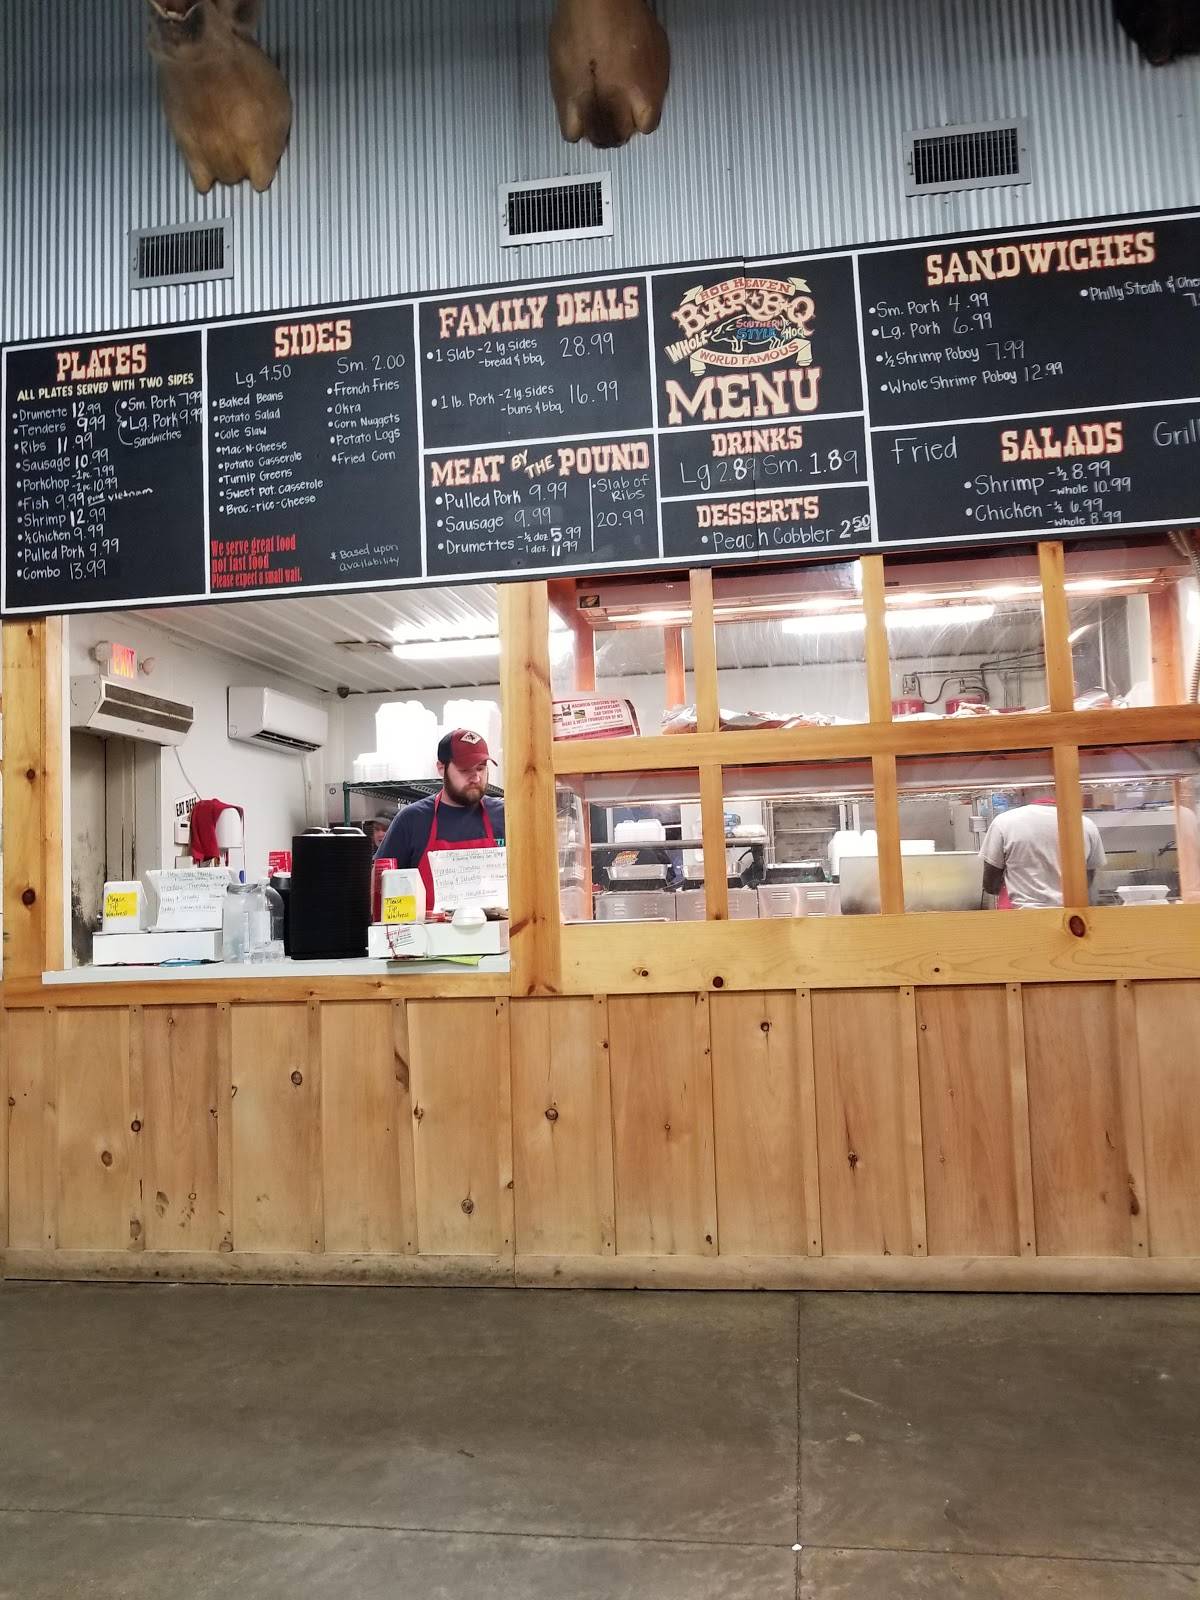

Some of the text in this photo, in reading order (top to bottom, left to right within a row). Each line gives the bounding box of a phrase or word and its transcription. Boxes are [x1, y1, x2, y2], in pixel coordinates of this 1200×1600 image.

[927, 232, 1155, 287] SANDWICHES
[700, 277, 791, 301] HOG HEAVEN
[1090, 280, 1162, 301] Philly Steak
[438, 286, 639, 339] FAMILY DEALS
[877, 292, 989, 318] Sm. Pork 4.99
[736, 319, 782, 339] SOUTHERN STYLE
[880, 312, 992, 339] Lg. Pork 6.99
[275, 319, 352, 357] SIDES
[447, 346, 475, 362] Slab
[560, 332, 614, 358] 28.99
[665, 330, 712, 364] WHOLE
[56, 344, 147, 381] PLATES
[700, 342, 798, 365] WORLD FAMOUS
[896, 340, 1024, 366] Shrimp Poboy 7.99
[337, 354, 405, 374] Sm. 2.00
[235, 364, 291, 388] Lg. 4.50
[888, 379, 928, 394] Whole
[931, 375, 977, 390] Shrimp
[1025, 362, 1063, 382] 12.99
[17, 373, 194, 401] ALL PLATES SERVED WITH TWO SIDES
[334, 378, 399, 396] French Fries
[469, 393, 495, 406] Pork
[569, 380, 618, 404] 16.99
[665, 367, 822, 425] MENU
[151, 395, 176, 409] Pork
[219, 392, 283, 408] Baked Beans
[335, 403, 361, 414] Okra
[20, 401, 101, 421] Drumette 12.99
[220, 408, 280, 424] Potato Salad
[334, 413, 400, 428] Corn Nuggets
[18, 414, 105, 437] Tenders 9.99
[130, 418, 150, 432] Lg.
[153, 414, 179, 428] Pork
[220, 426, 267, 439] Cole Slaw
[20, 440, 46, 455] Ribs
[337, 429, 400, 446] Potato Logs
[711, 425, 802, 457] DRINKS
[1001, 421, 1123, 463] SALADS
[22, 448, 108, 472] Sausage 10.99
[337, 450, 395, 464] Fried Corn
[891, 436, 958, 464] Fried
[225, 451, 302, 471] Potato Casserole
[431, 441, 649, 488] MEAT BY THE POUND
[763, 455, 802, 474] Sm.
[809, 449, 858, 475] 1.89
[94, 477, 117, 492] 10.99
[223, 469, 292, 485] Turnip Greens
[597, 474, 650, 492] Slab of
[974, 460, 1110, 495] Shrimp 8.99
[1094, 477, 1131, 493] 10.99
[23, 497, 49, 510] Fish
[55, 491, 84, 509] 9.99
[225, 486, 255, 500] Sweet
[445, 482, 567, 511] Pulled Pork 9.99
[612, 490, 645, 503] Ribs
[24, 507, 106, 527] Shrimp 12.99
[445, 507, 551, 533] Sausage 9.99
[597, 509, 644, 528] 20.99
[696, 496, 819, 528] DESSERTS
[975, 498, 1102, 522] Chicken 6.99
[1091, 511, 1121, 524] 8.99
[32, 524, 104, 543] Chicken 9.99
[446, 527, 581, 554] Drumettes 5.99
[713, 525, 835, 552] Peach Cobbler
[25, 538, 119, 562] Pulled Pork 9.99
[211, 534, 296, 557] We serve great food
[340, 544, 398, 559] Based upon
[23, 559, 106, 580] Combo 13.99
[212, 557, 226, 573] not
[249, 553, 269, 569] food
[340, 557, 399, 571] availability
[212, 573, 233, 588] Please
[265, 568, 283, 584] small
[176, 802, 184, 817] EAT
